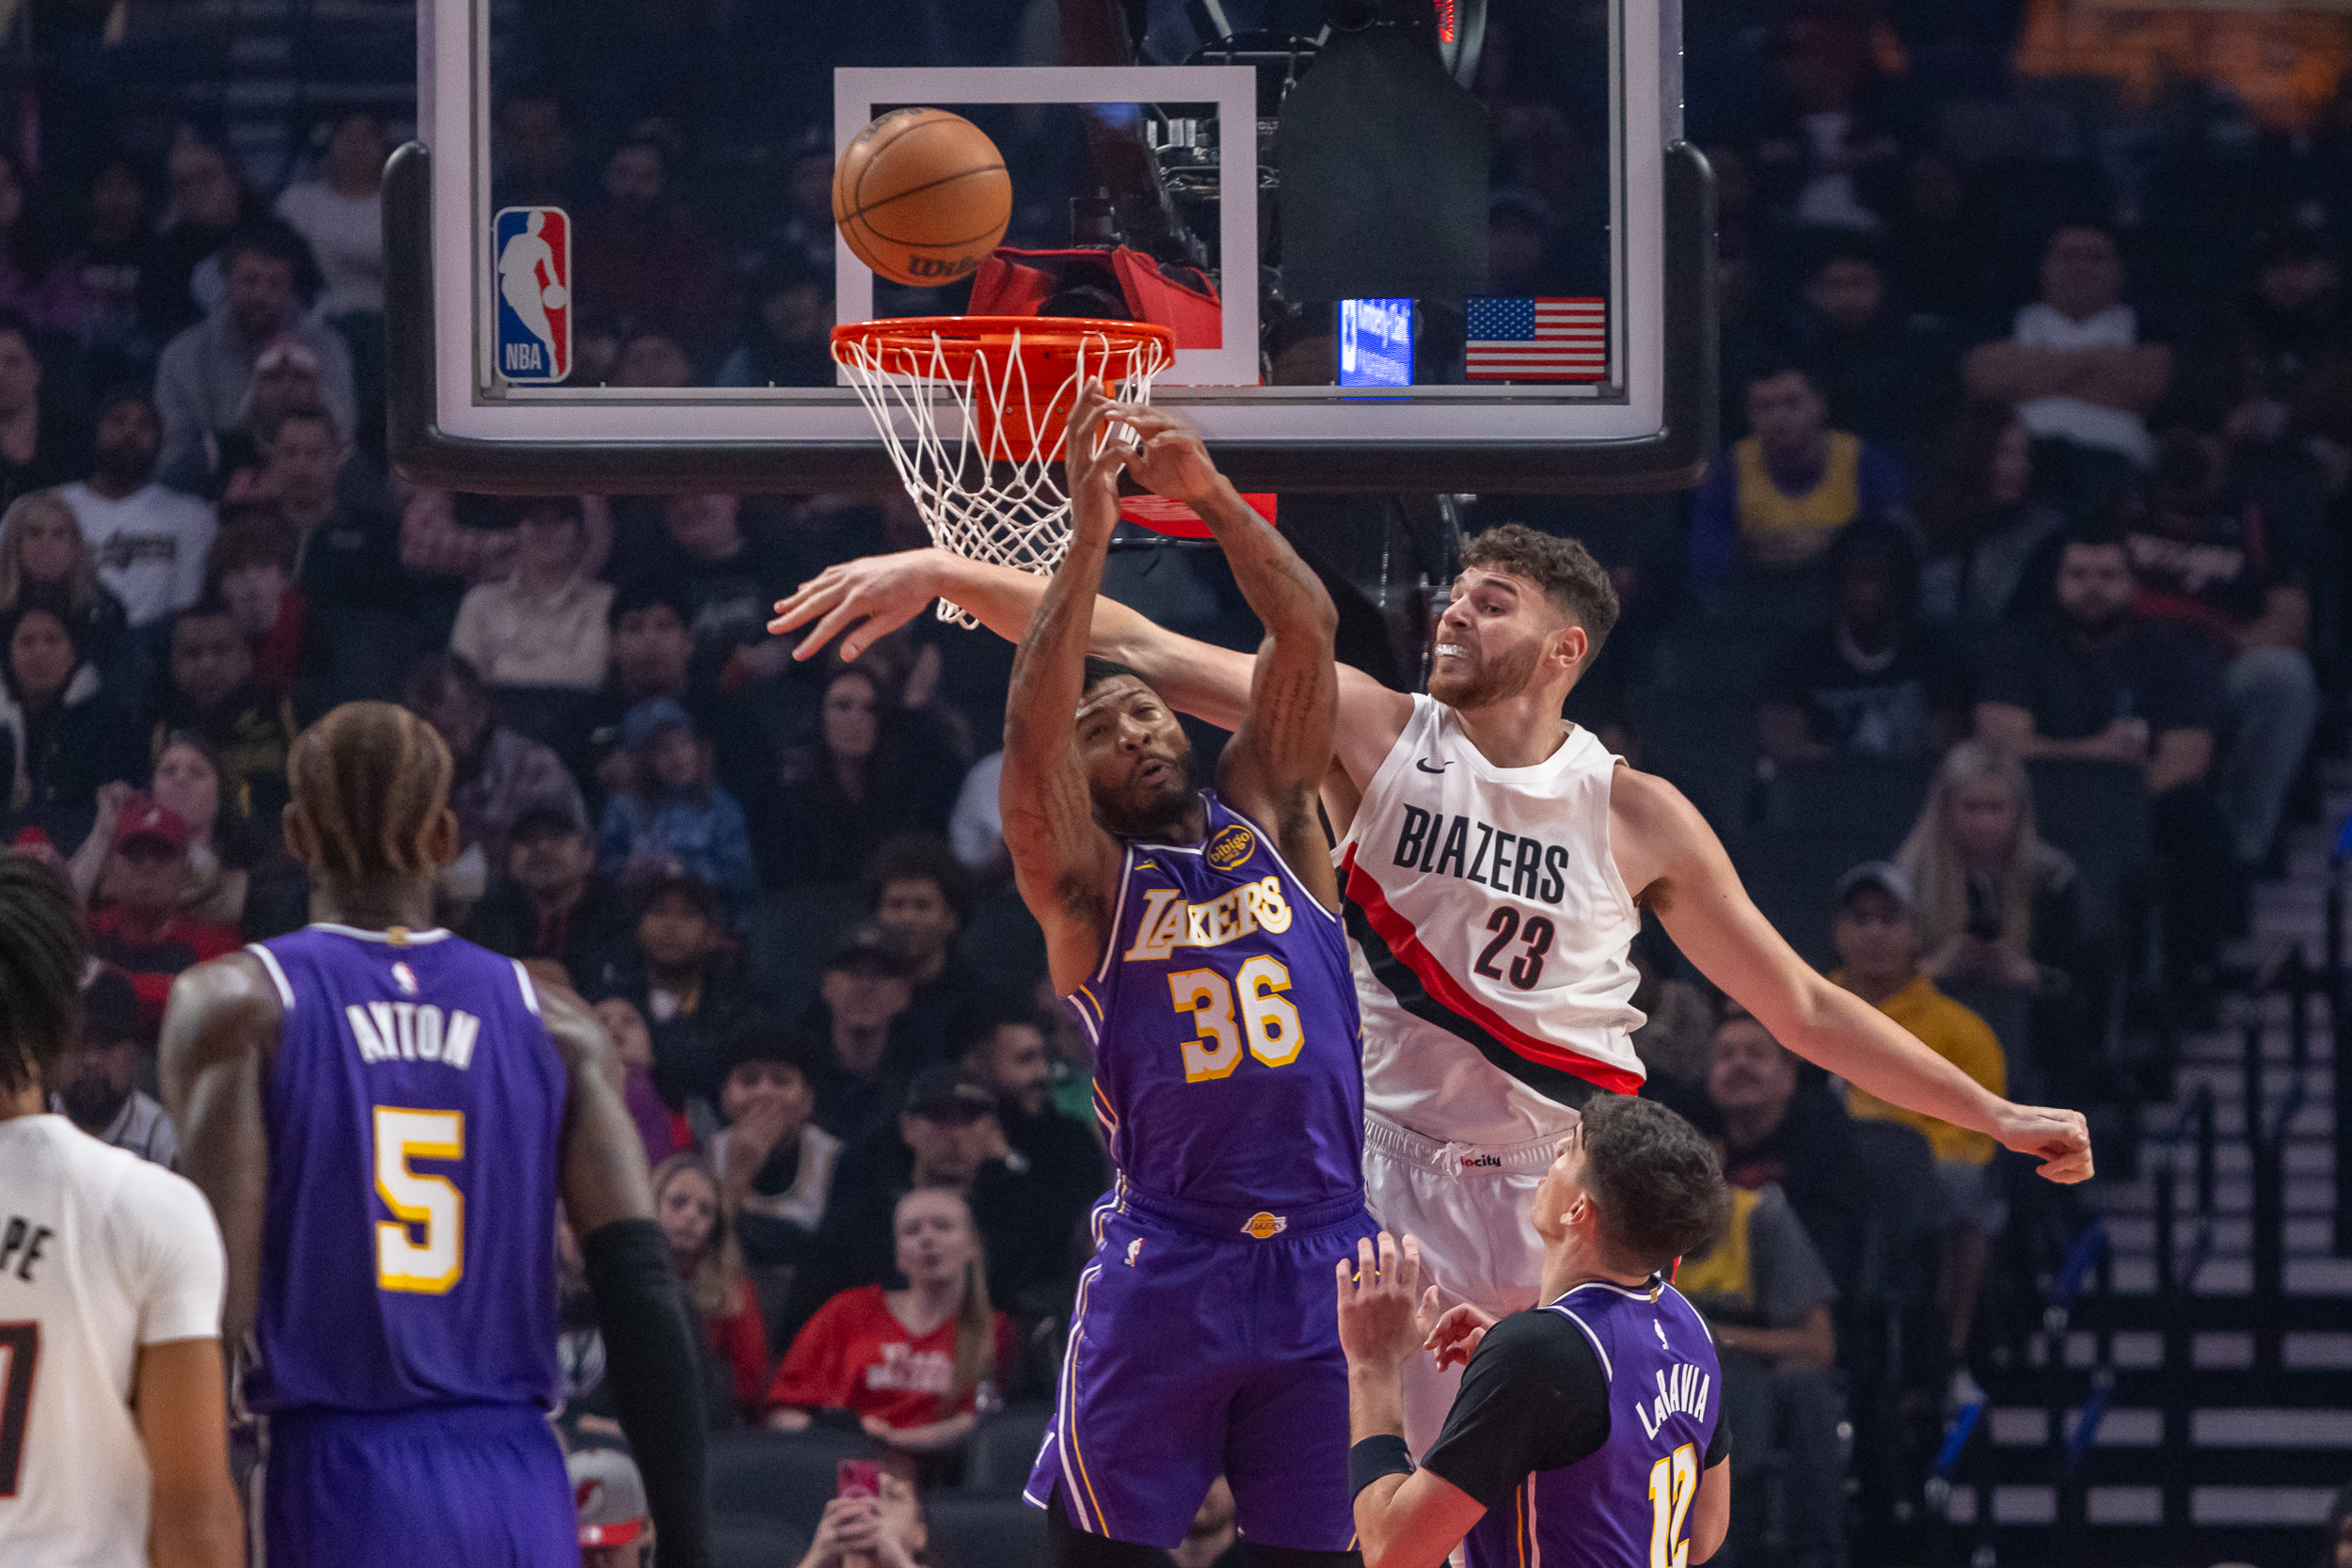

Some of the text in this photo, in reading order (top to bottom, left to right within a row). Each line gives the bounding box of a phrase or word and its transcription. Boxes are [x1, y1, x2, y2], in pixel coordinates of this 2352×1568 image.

[505, 342, 542, 371] NBA
[1210, 832, 1251, 863] bibigo
[1391, 802, 1569, 905] BLAZERS
[1123, 876, 1293, 962] LAKERS
[1473, 905, 1556, 991] 23
[344, 1000, 482, 1071] AYTON
[1167, 954, 1306, 1084] 36
[373, 1104, 466, 1296] 5
[1648, 1442, 1698, 1568] 12
